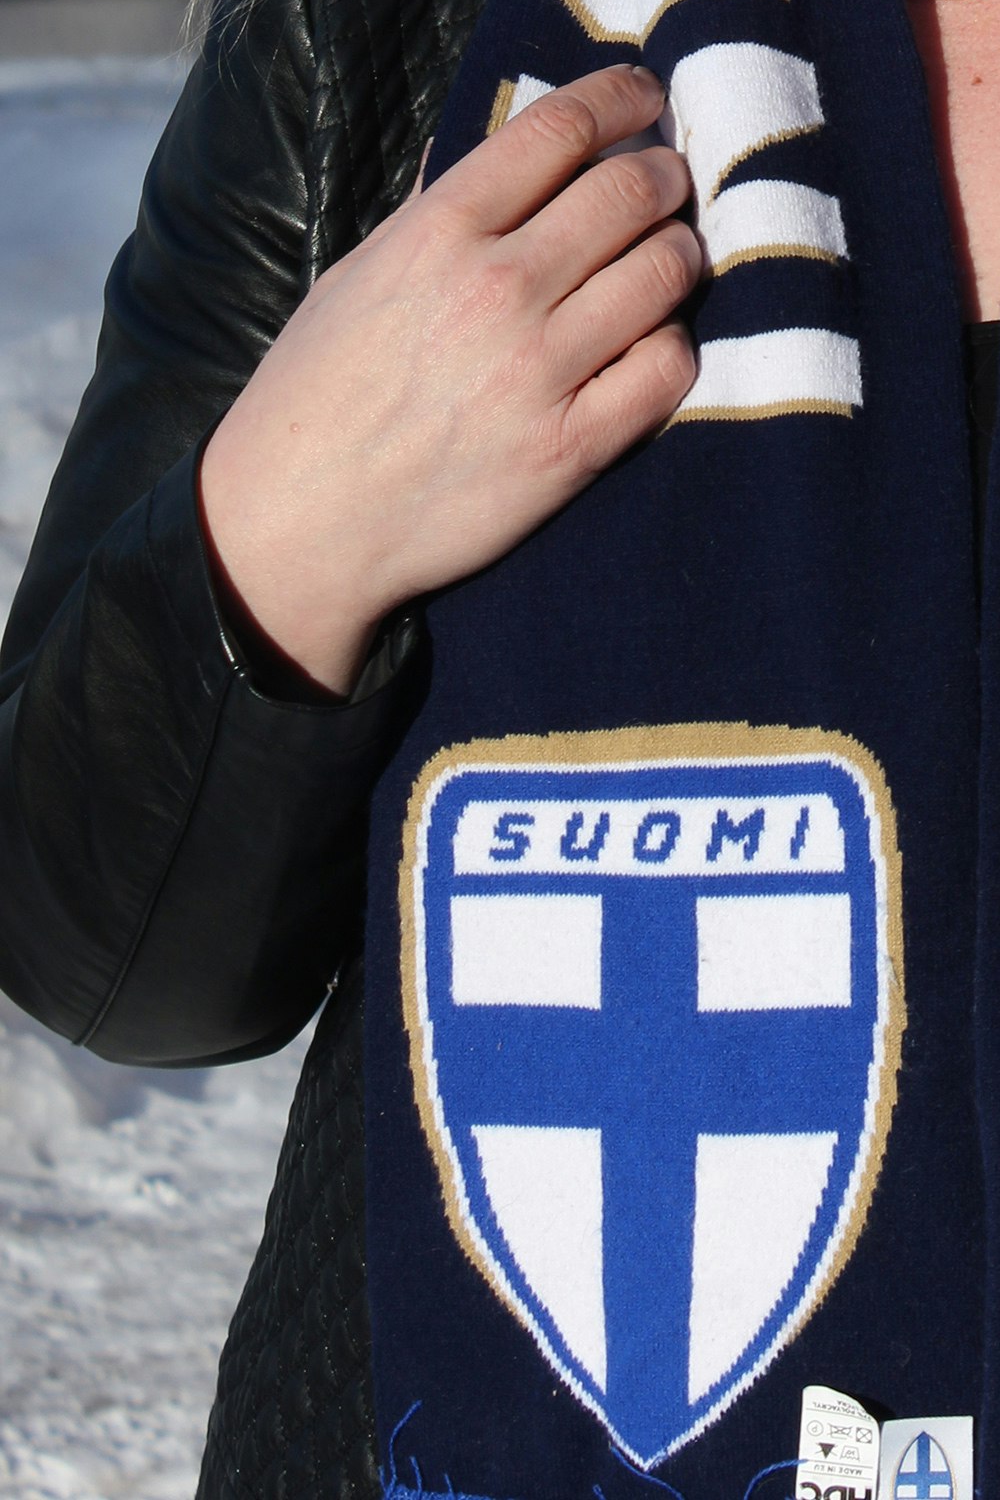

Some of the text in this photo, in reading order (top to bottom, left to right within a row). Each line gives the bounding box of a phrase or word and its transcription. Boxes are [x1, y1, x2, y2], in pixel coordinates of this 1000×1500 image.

[489, 806, 809, 863] SUOMI
[814, 1464, 863, 1476] MADE IN EU
